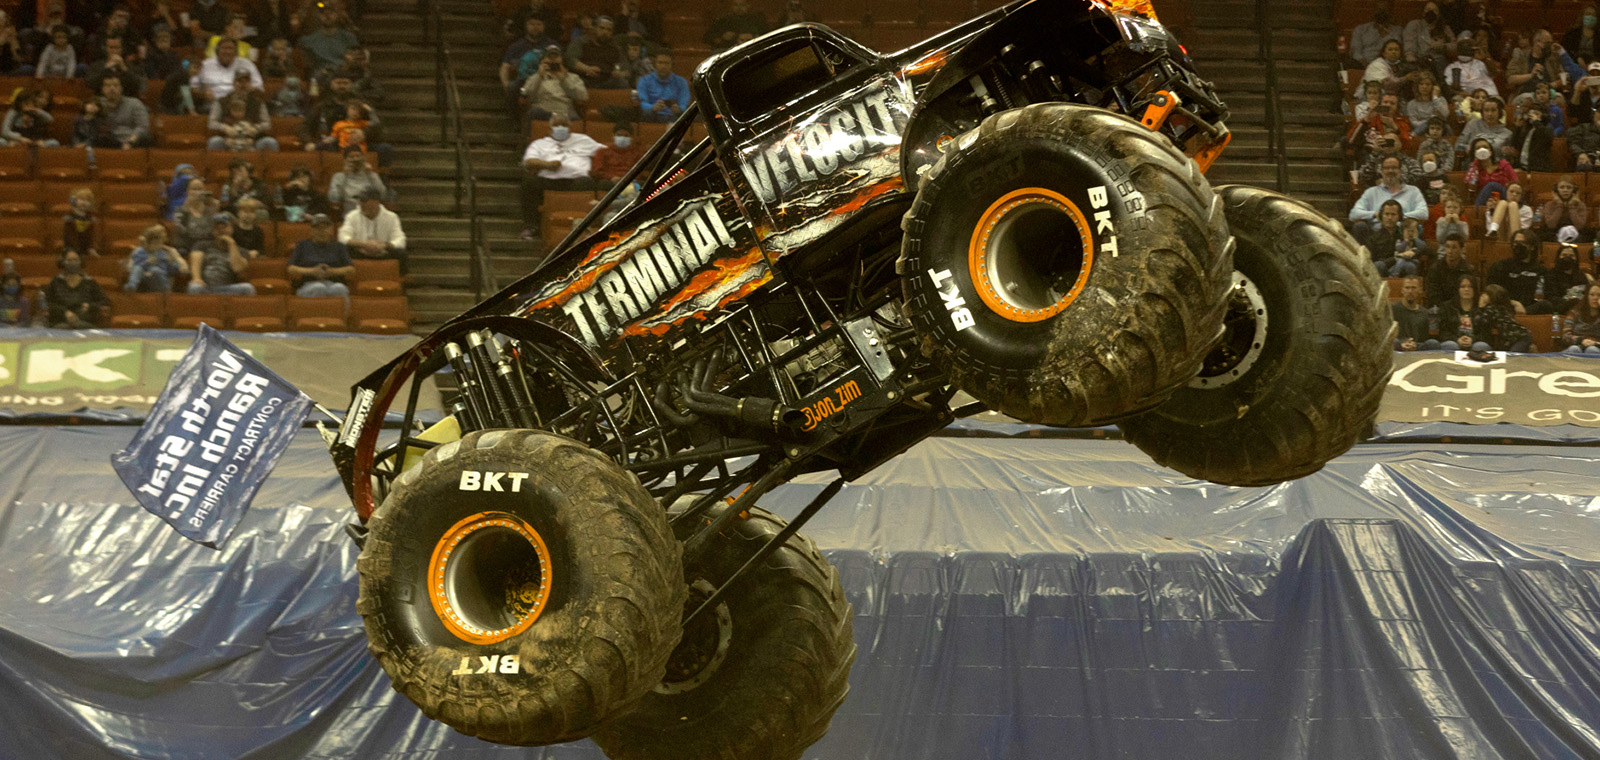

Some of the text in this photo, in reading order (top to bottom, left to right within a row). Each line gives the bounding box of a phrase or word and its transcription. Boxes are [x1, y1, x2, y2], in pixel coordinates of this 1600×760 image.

[1086, 185, 1118, 257] BKT
[562, 200, 732, 348] TERMINAL
[927, 268, 975, 332] BKT
[1421, 404, 1505, 419] IT'S
[459, 470, 529, 494] BKT
[451, 654, 520, 676] BKT
